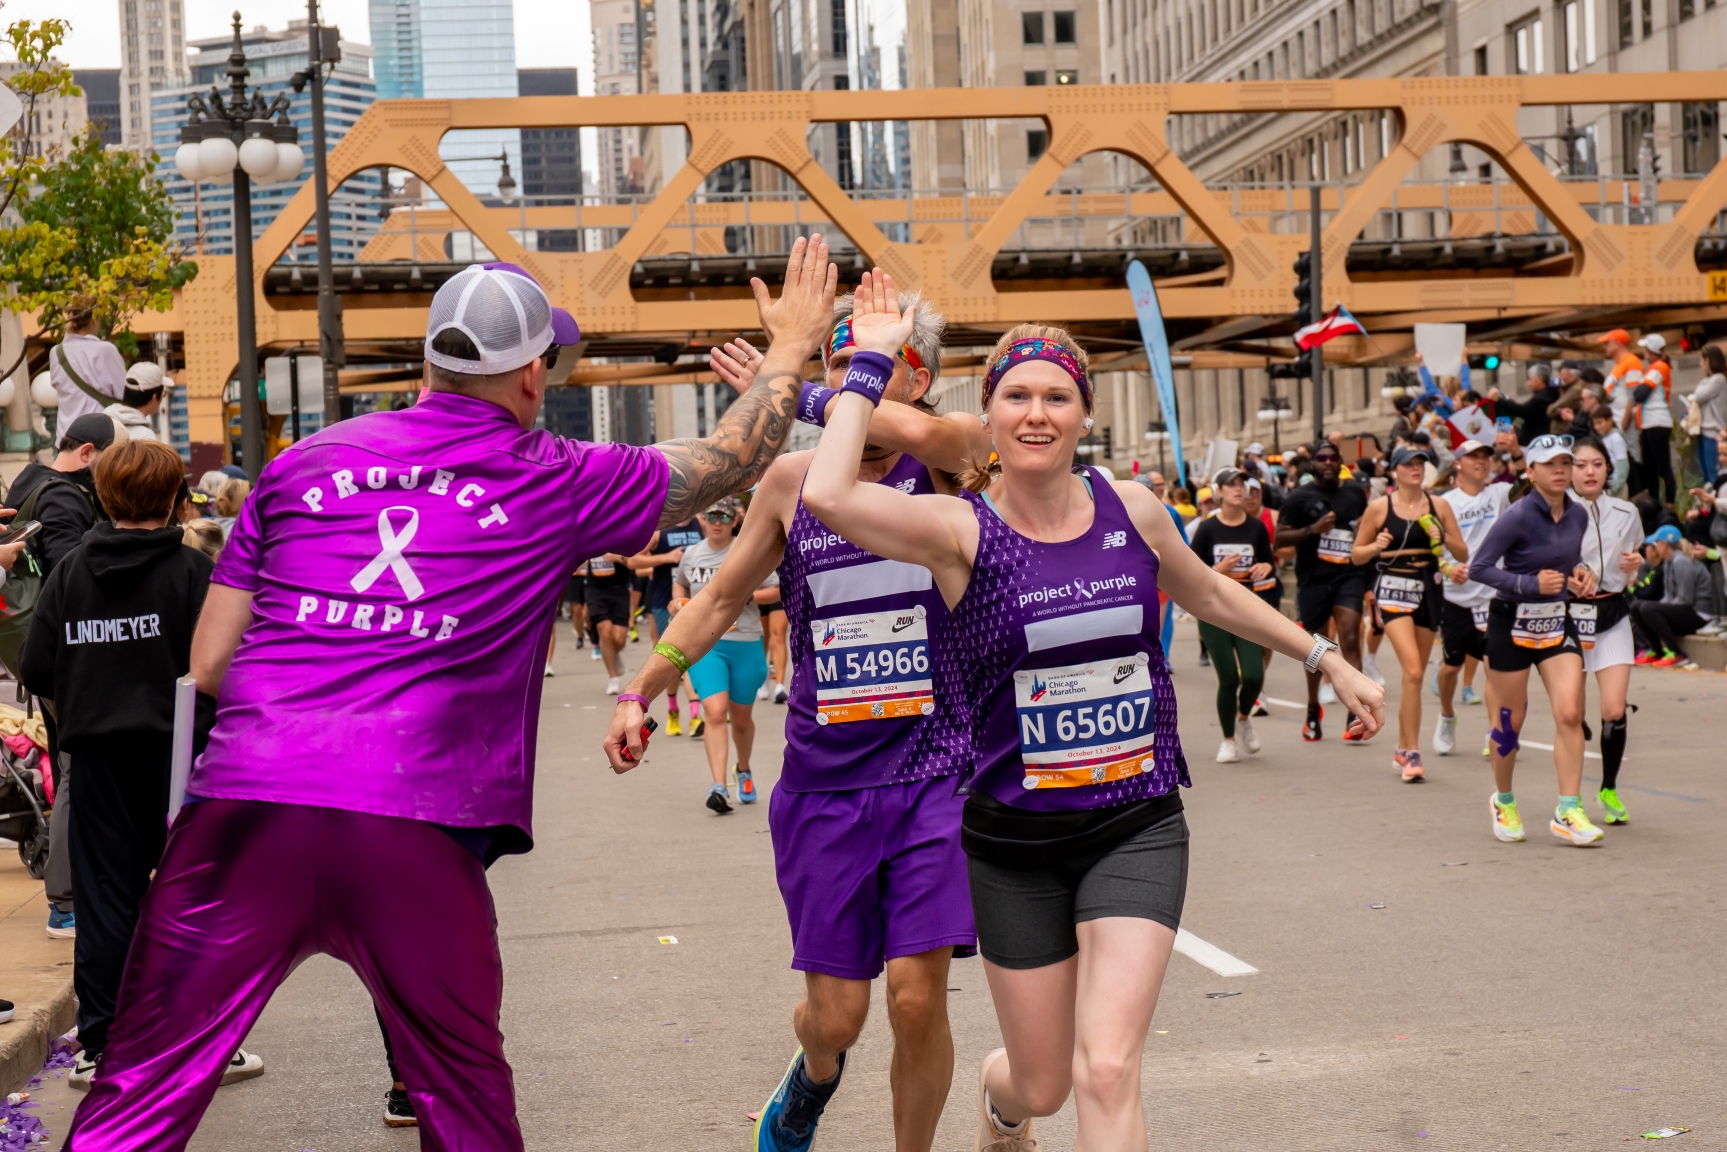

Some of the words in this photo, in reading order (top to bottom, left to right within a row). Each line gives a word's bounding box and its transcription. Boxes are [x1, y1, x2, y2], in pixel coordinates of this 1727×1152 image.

[848, 370, 885, 394] purple
[301, 465, 510, 530] PROJECT
[800, 532, 847, 556] projec
[815, 557, 835, 566] WORLD
[835, 551, 863, 563] WITHOUT
[1018, 583, 1073, 609] project
[1089, 573, 1137, 595] purple
[1036, 607, 1058, 617] WORLD
[1058, 602, 1083, 612] WITHOUT
[1083, 597, 1115, 608] PANCREATIC
[1114, 594, 1134, 603] CANCER
[65, 613, 162, 645] LINDMEYER
[295, 595, 460, 642] PURPLE
[895, 615, 915, 626] RUN
[1526, 617, 1565, 633] 66697
[836, 627, 862, 635] Chicago
[815, 655, 838, 683] M
[846, 645, 929, 680] 54966
[1116, 663, 1136, 676] RUN
[1048, 680, 1079, 690] Chicago
[1021, 712, 1047, 746] N
[1056, 696, 1151, 742] 65607
[1106, 745, 1122, 753] 2024
